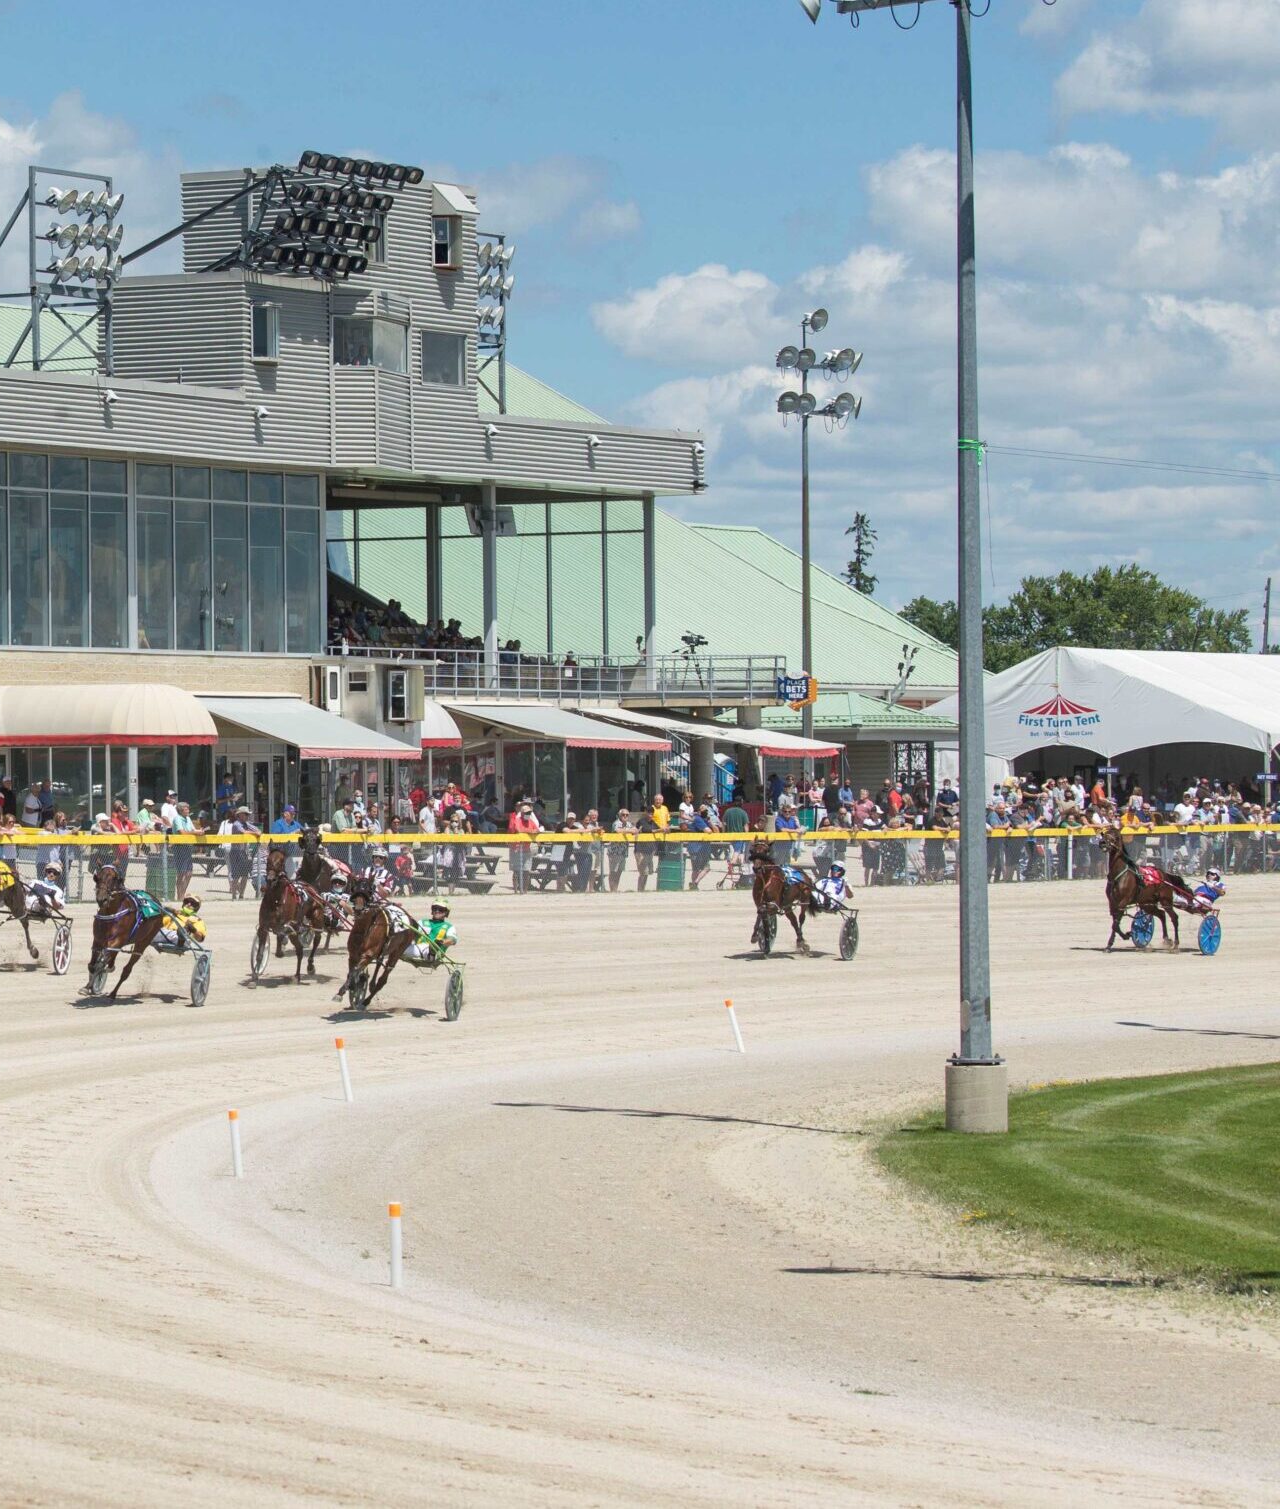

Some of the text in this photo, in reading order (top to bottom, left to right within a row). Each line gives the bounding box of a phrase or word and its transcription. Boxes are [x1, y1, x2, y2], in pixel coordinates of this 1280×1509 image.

[786, 685, 807, 693] BETS
[1019, 713, 1100, 728] First Turn Tent
